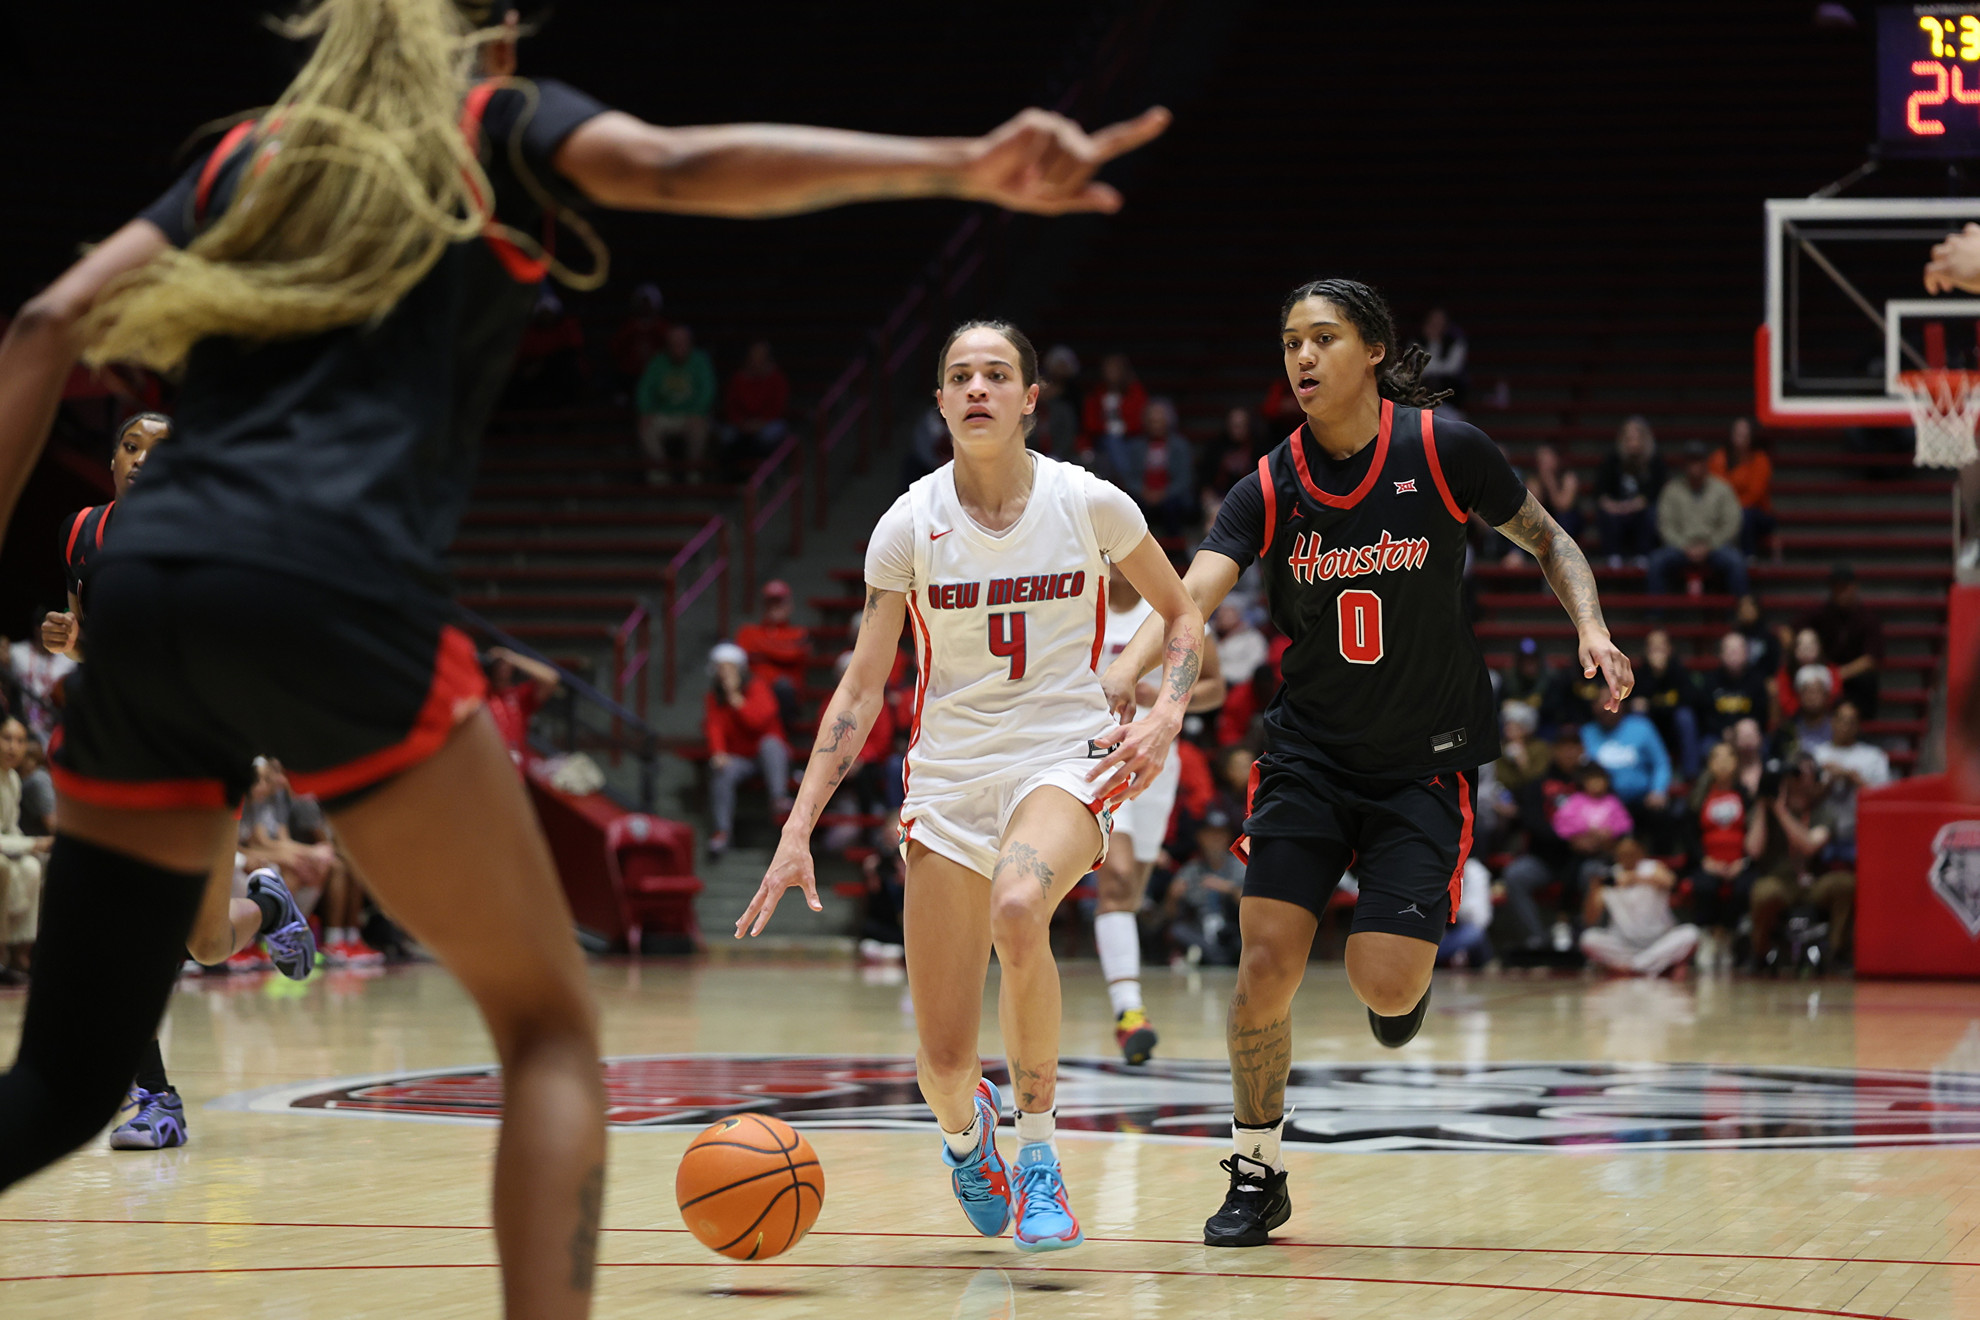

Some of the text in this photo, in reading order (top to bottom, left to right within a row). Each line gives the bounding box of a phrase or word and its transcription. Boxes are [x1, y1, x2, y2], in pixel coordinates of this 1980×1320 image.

[1288, 529, 1430, 585] Houston
[928, 570, 1085, 610] NEW MEXICO
[988, 611, 1027, 681] 4
[1337, 589, 1384, 665] 0
